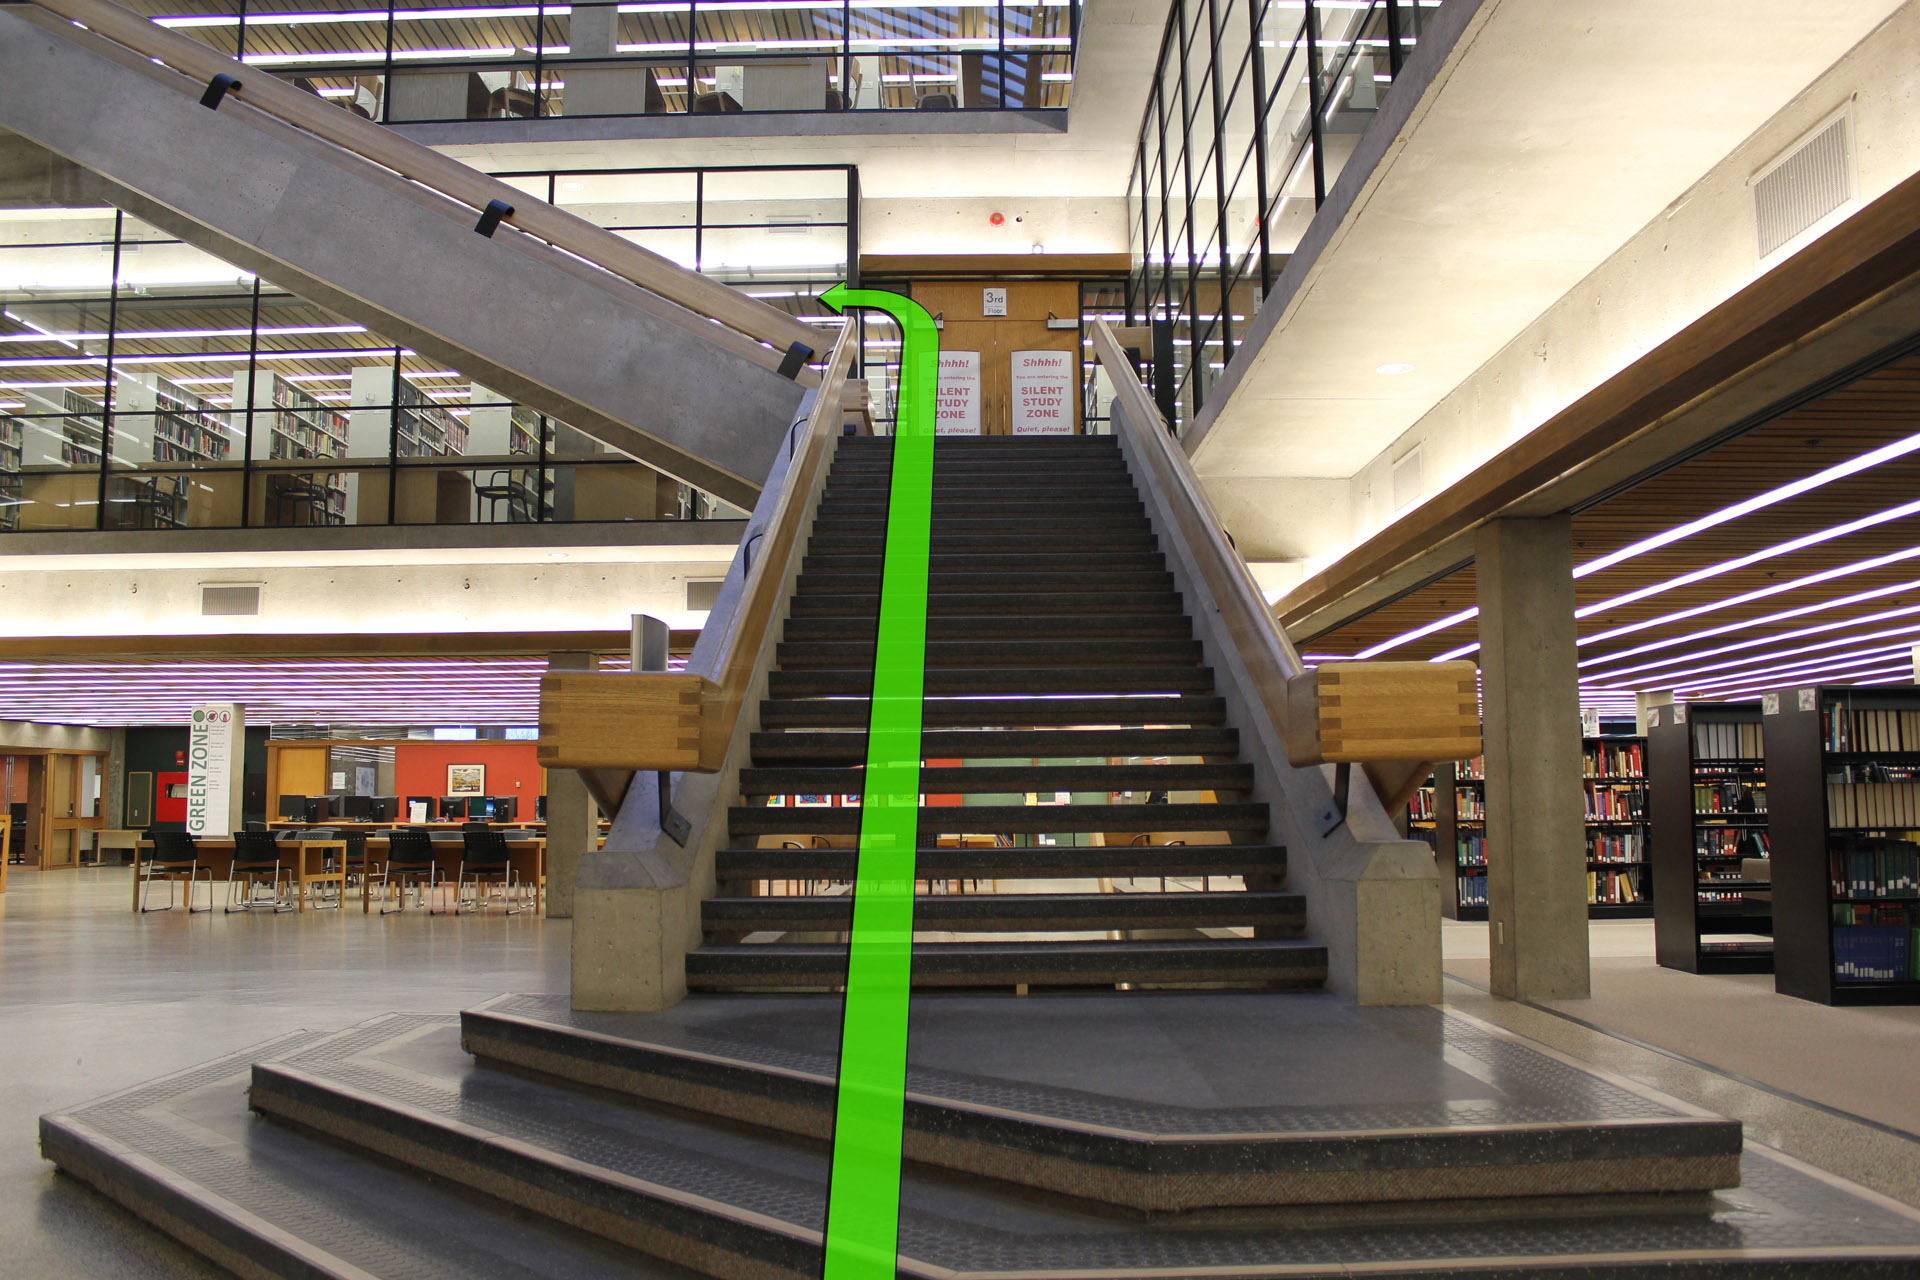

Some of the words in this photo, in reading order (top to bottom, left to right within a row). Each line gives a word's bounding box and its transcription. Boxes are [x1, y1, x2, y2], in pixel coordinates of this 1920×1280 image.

[986, 292, 1003, 303] 3rd
[1023, 358, 1062, 367] Shhhh!
[1021, 386, 1064, 395] SILENT
[1023, 398, 1062, 407] STUDY
[934, 410, 966, 419] ZONE
[1026, 409, 1060, 418] ZONE
[1016, 426, 1040, 434] Quiet,
[1041, 426, 1071, 434] please!
[191, 724, 208, 770] ZONE
[189, 775, 207, 832] GREEN
